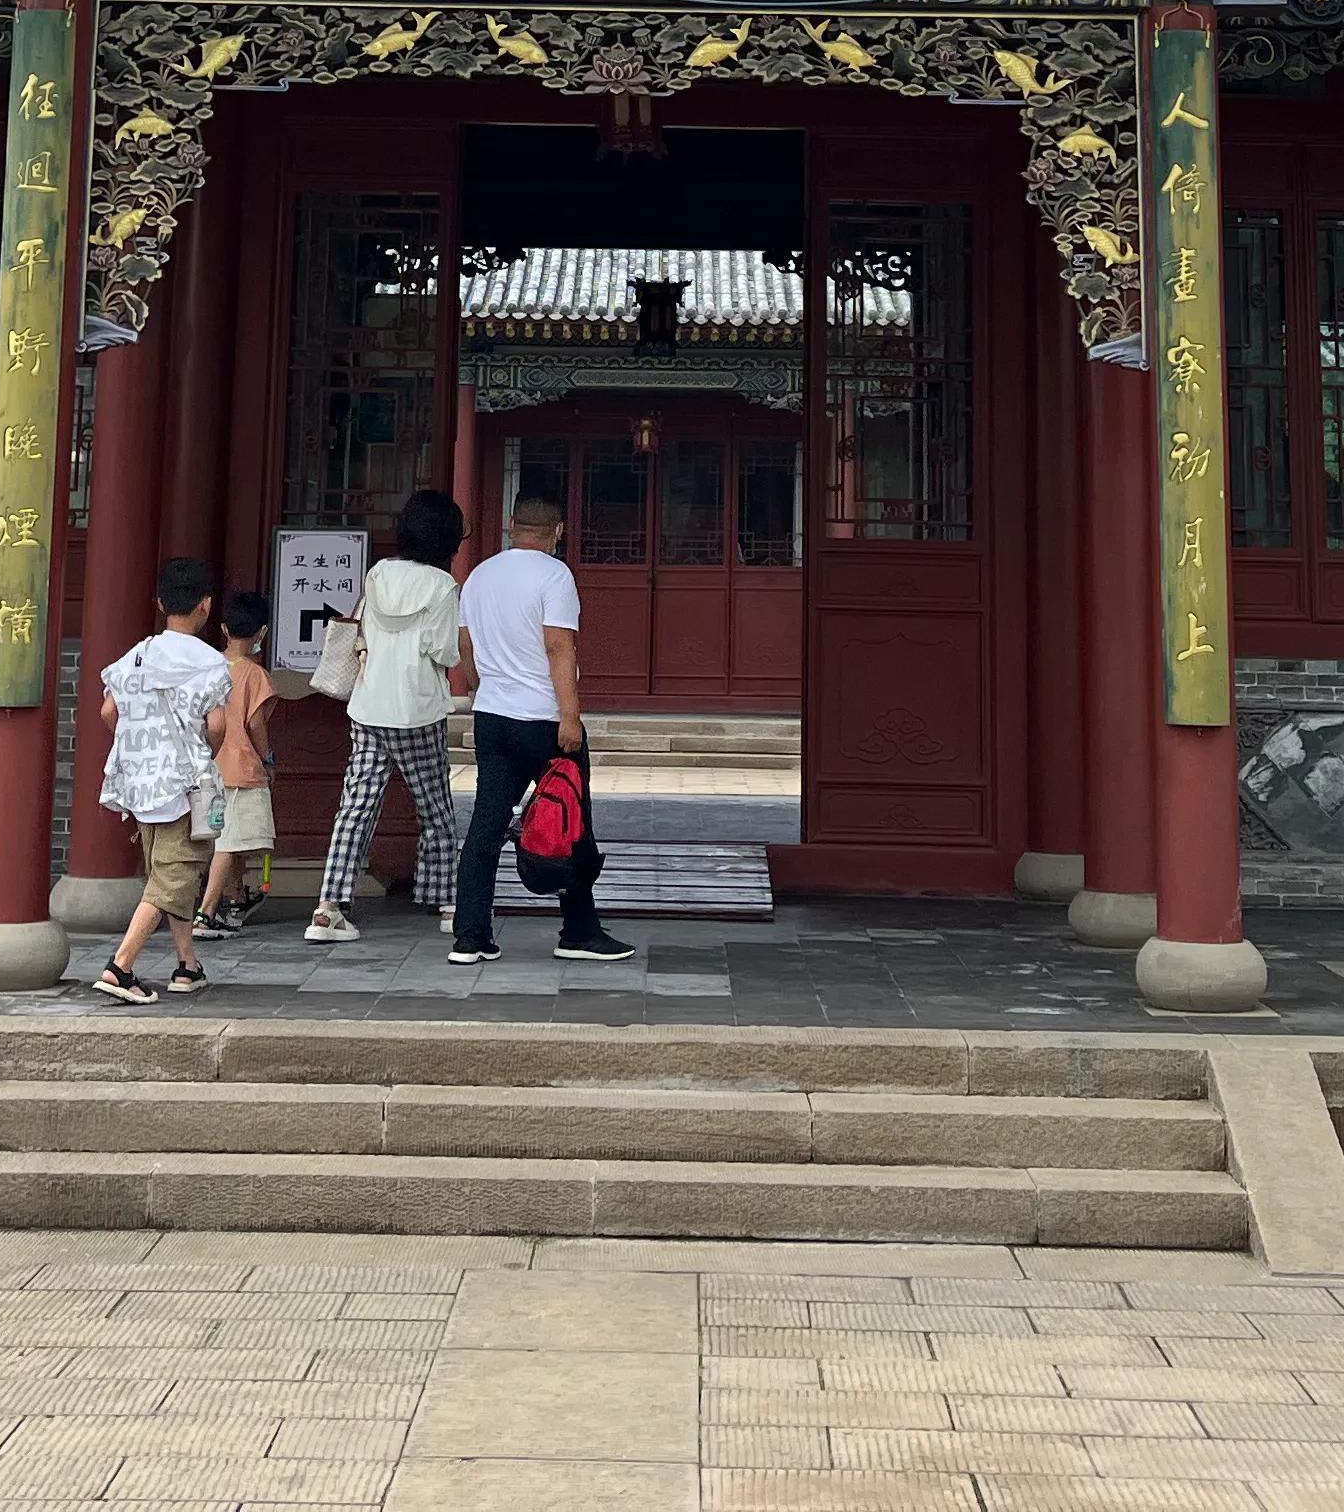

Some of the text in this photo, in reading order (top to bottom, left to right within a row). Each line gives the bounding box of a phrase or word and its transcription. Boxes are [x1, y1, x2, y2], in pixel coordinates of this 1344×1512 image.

[290, 553, 351, 569] 卫生间
[291, 577, 353, 594] 开水间
